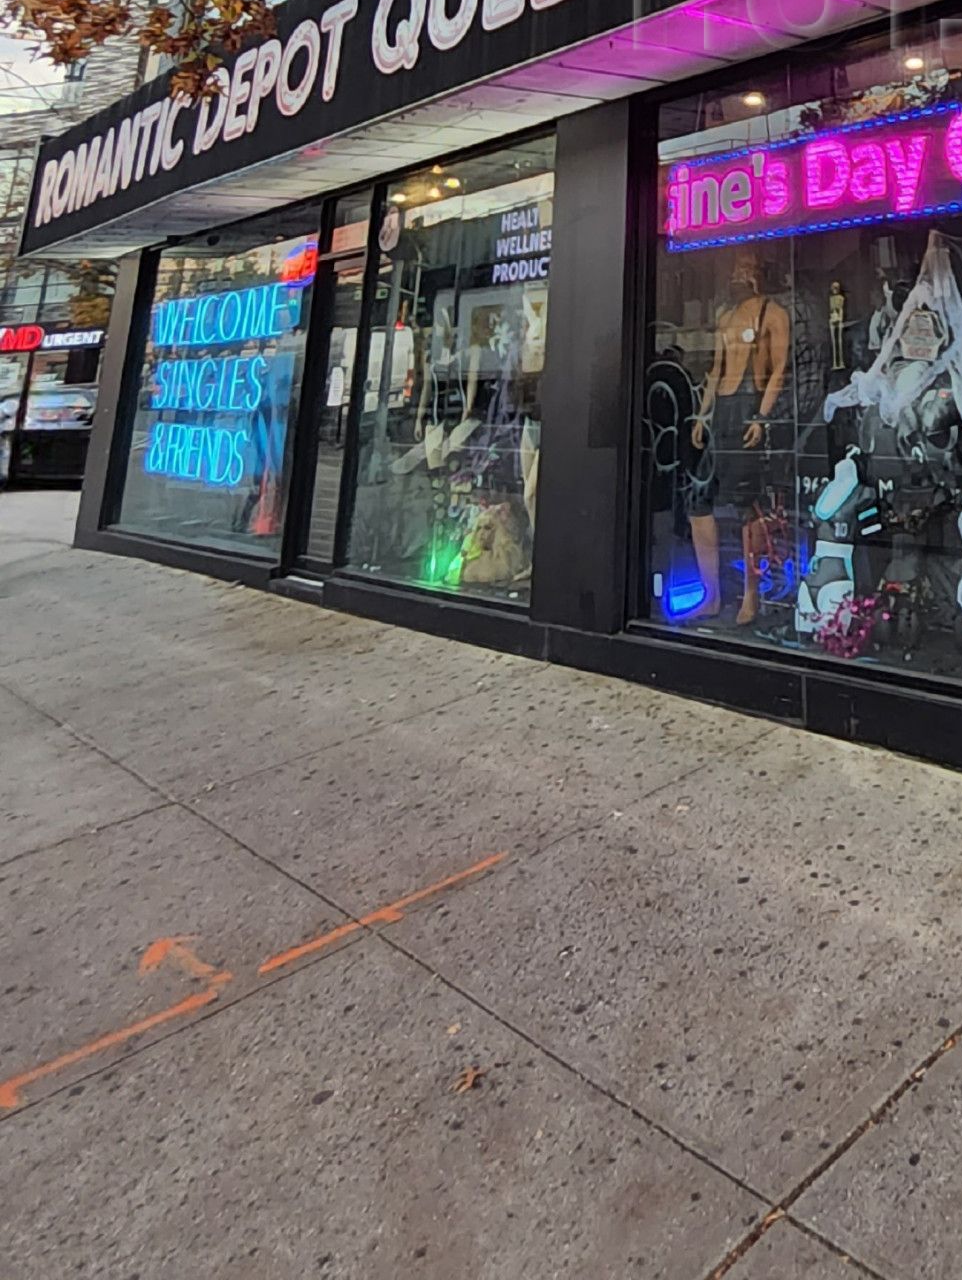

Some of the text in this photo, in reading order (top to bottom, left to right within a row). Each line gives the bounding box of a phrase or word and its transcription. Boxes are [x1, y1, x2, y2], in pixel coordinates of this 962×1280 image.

[34, 90, 192, 228] ROMANTIC
[669, 152, 789, 232] ine's
[805, 135, 930, 211] Day
[492, 256, 551, 284] PRODUC
[0, 325, 104, 350] MD URGENT
[153, 282, 289, 346] WELCOME
[154, 356, 267, 410] SINGLES
